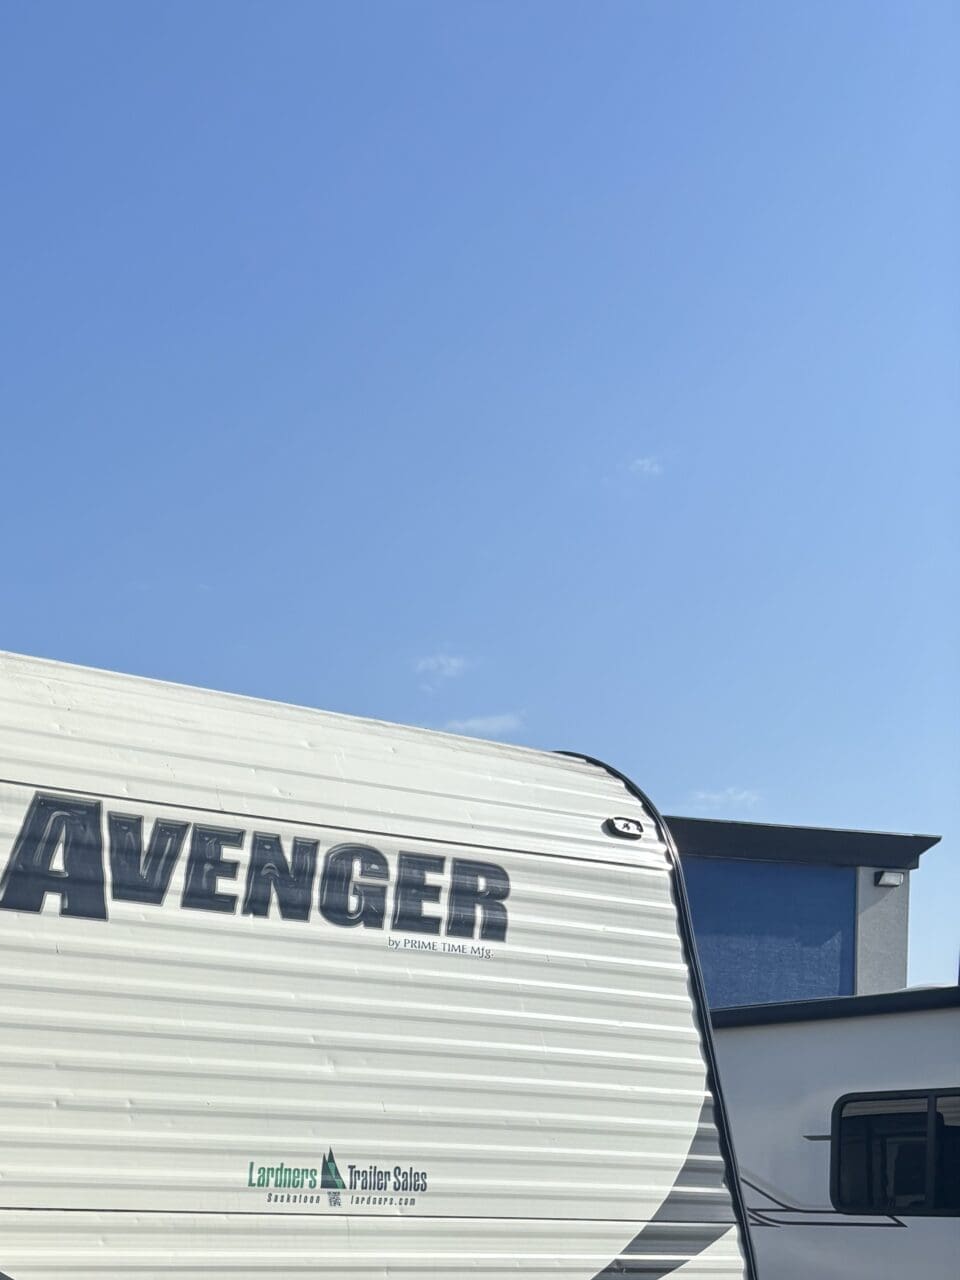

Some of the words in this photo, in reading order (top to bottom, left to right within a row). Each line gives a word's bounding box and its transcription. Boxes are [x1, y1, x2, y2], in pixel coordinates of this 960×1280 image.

[388, 936, 401, 950] by
[403, 938, 438, 951] PRIME
[441, 942, 468, 954] TIME
[470, 946, 495, 959] Mfg.
[248, 1161, 318, 1189] Lardners
[347, 1164, 392, 1191] Trailer
[393, 1166, 428, 1192] Sales
[267, 1192, 322, 1205] Saskatoon
[350, 1195, 417, 1207] lardners.com
